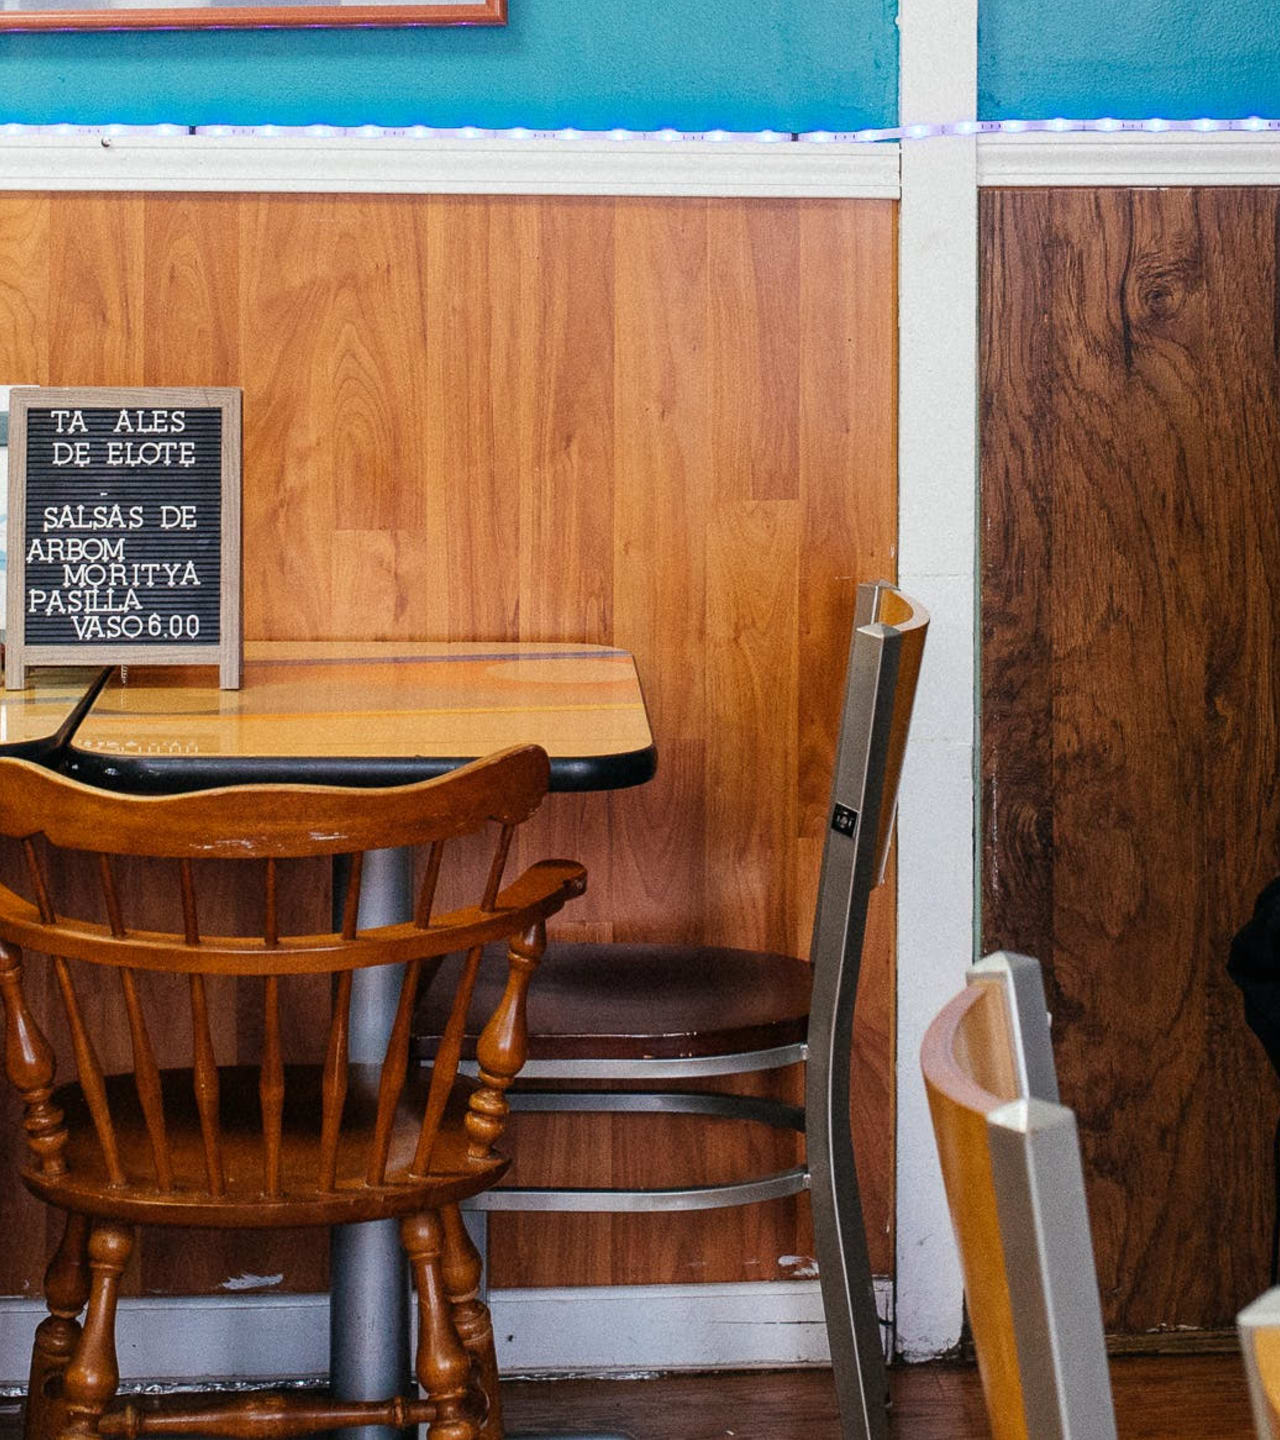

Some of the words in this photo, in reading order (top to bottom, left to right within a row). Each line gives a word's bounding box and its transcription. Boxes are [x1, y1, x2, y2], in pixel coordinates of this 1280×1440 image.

[52, 442, 90, 467] DE
[107, 442, 196, 467] ELOTE
[43, 504, 144, 532] SALSAS
[160, 506, 197, 529] DE
[26, 538, 125, 563] ARBOM
[28, 588, 143, 615] PASILLA
